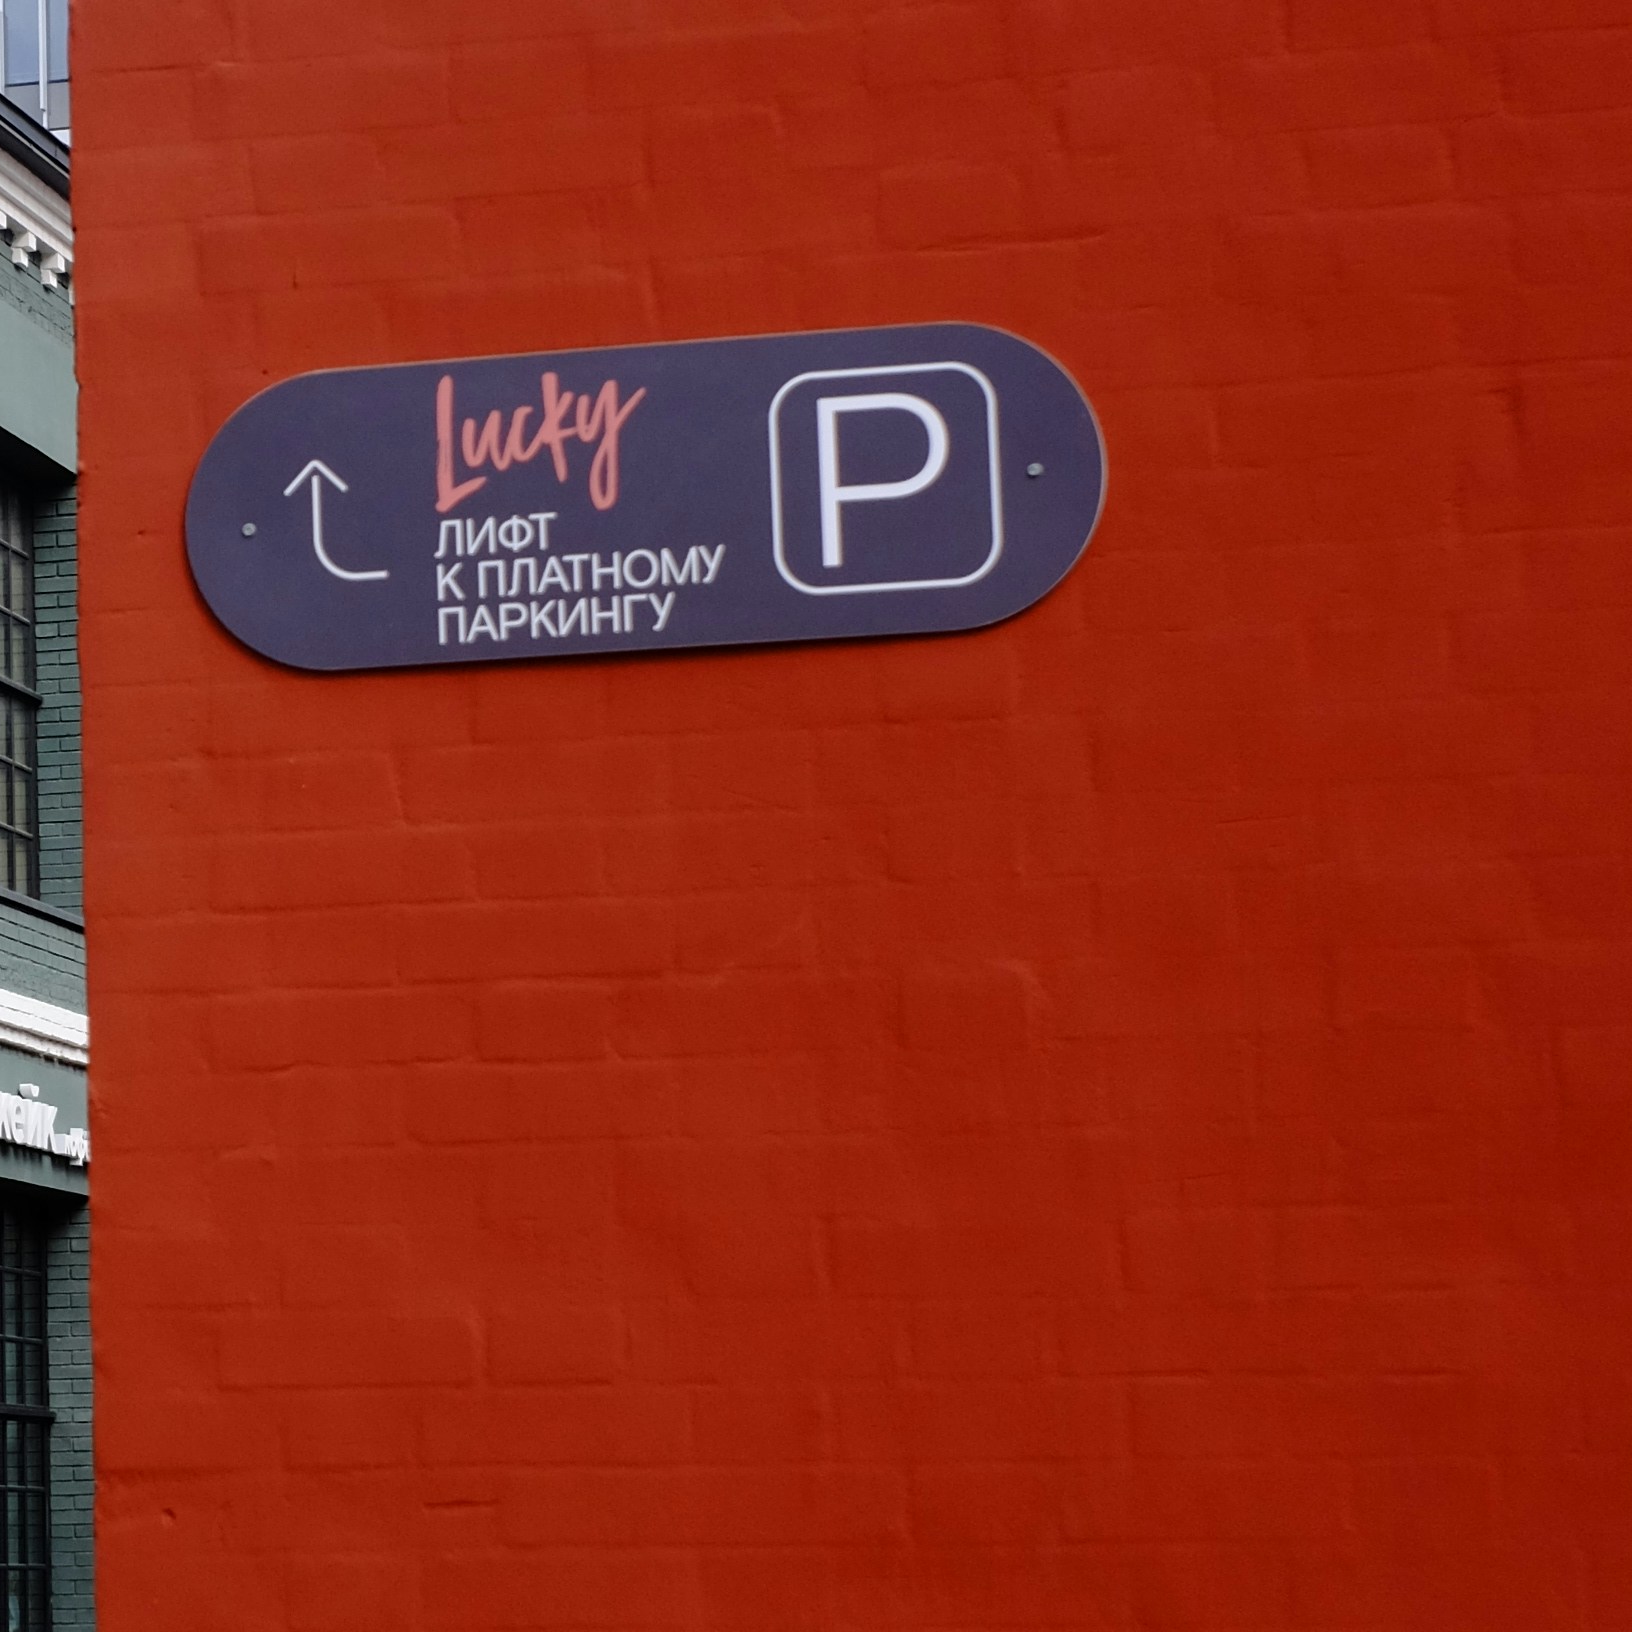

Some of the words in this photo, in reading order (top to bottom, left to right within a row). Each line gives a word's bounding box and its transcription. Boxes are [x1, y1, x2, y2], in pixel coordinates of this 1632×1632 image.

[434, 371, 648, 515] Lucky
[815, 392, 951, 568] P
[434, 511, 558, 560] ЛИФТ
[436, 562, 465, 602] К
[477, 544, 726, 596] ПЛАТНОМУ
[437, 591, 675, 645] ПАРКИНГУ
